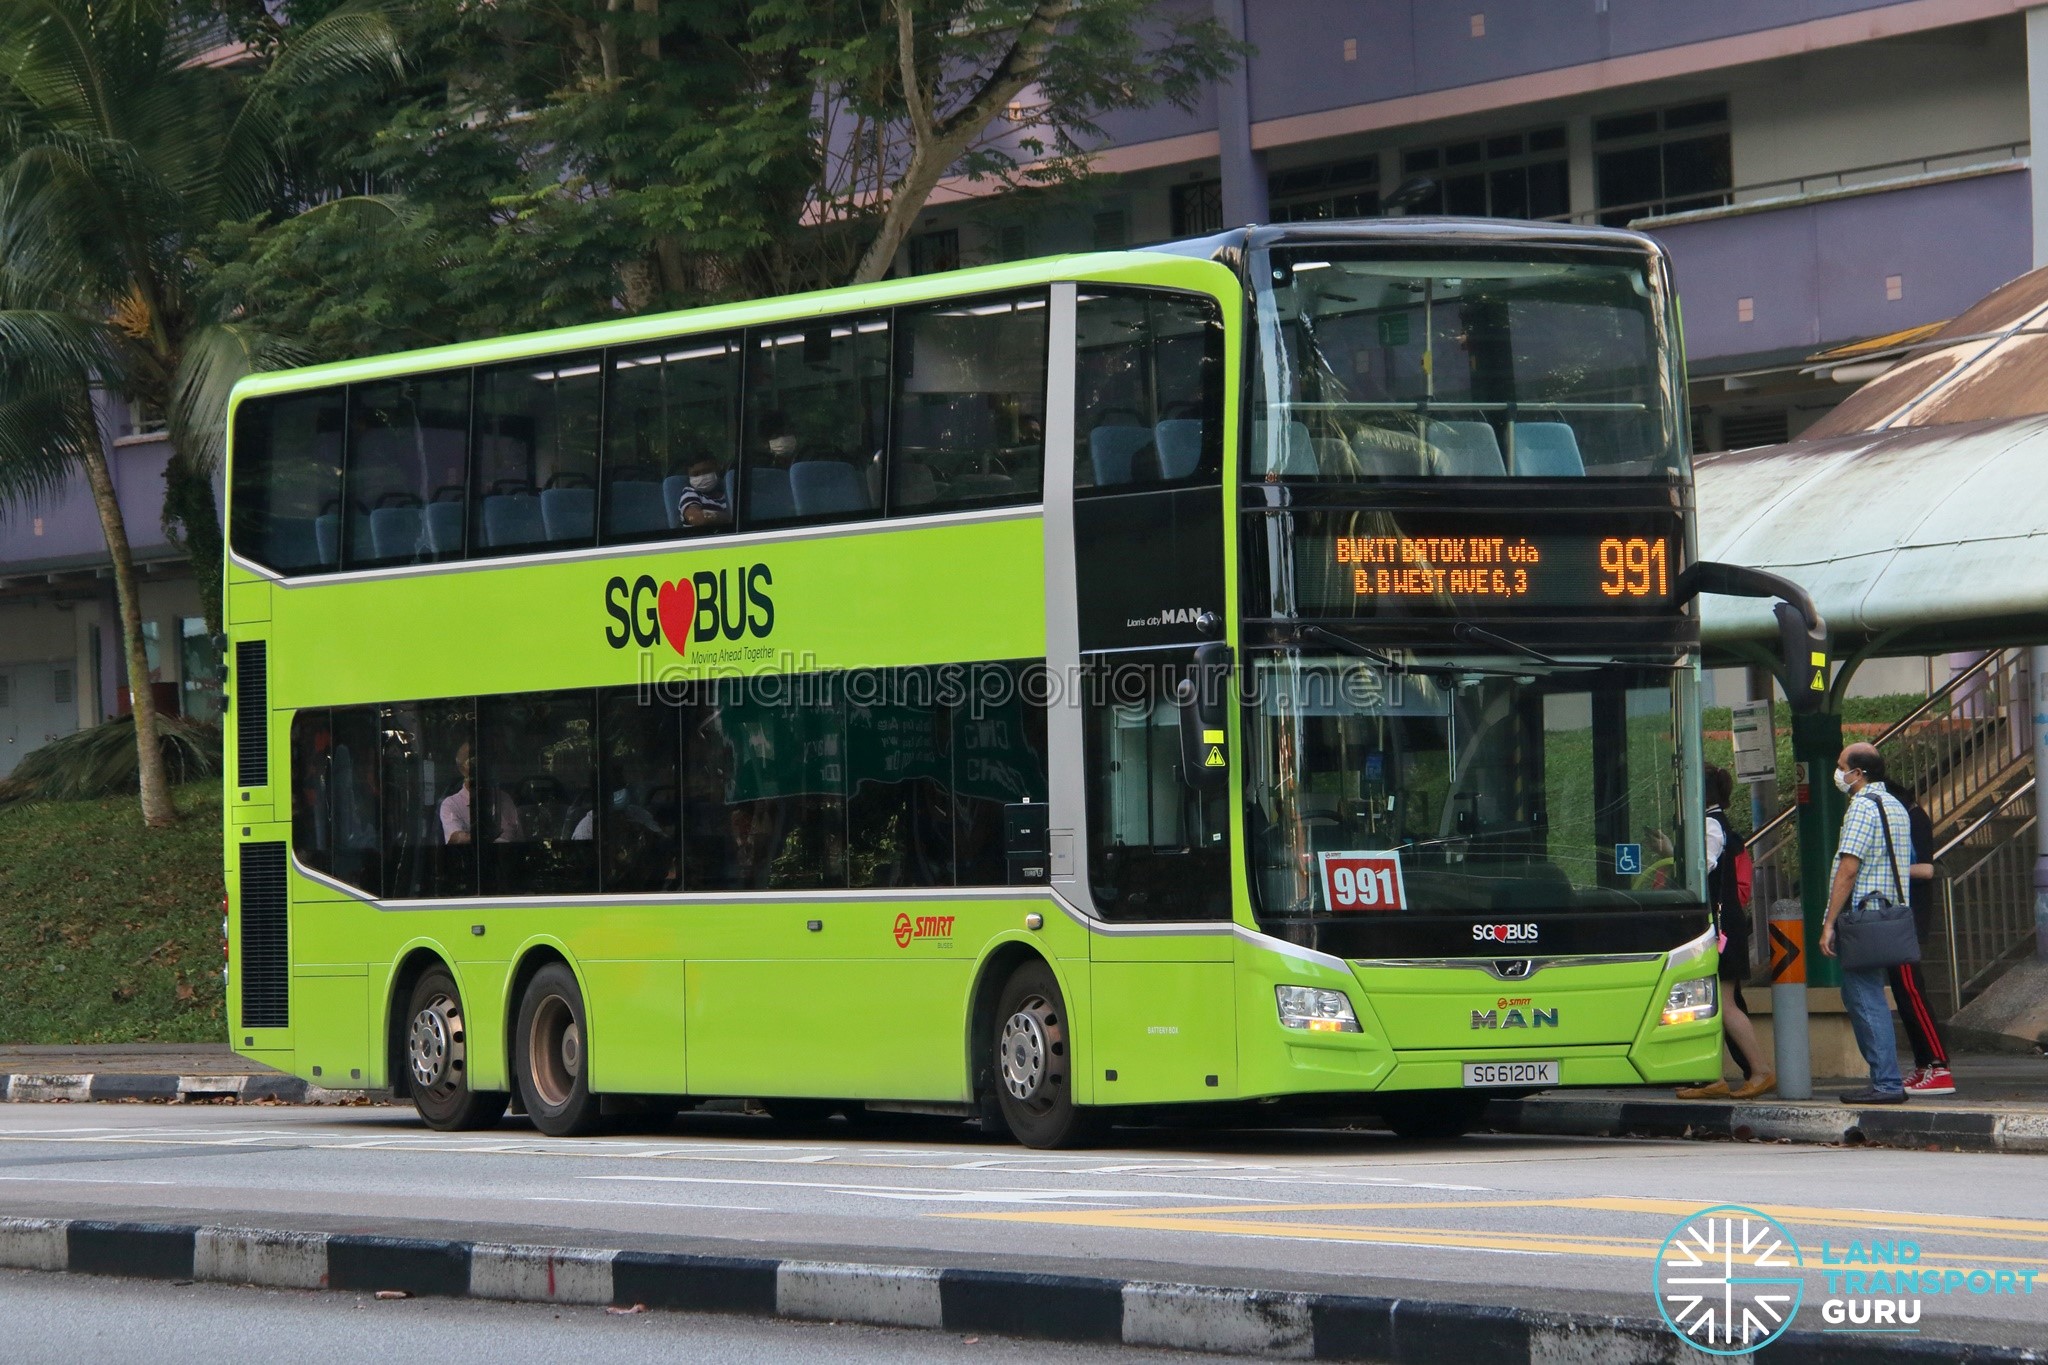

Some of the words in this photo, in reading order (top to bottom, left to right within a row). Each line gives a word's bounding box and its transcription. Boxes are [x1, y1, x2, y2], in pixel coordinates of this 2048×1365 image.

[1337, 538, 1398, 563] BUKIT
[1401, 538, 1466, 563] BATOK
[1469, 538, 1504, 563] INT
[1507, 538, 1540, 563] via
[1600, 538, 1667, 595] 991
[1393, 568, 1447, 594] WEST
[1450, 568, 1489, 593] AVE
[1161, 607, 1202, 625] MAN
[691, 650, 718, 665] Moving
[719, 647, 743, 662] Ahead
[744, 645, 776, 662] Together
[1333, 866, 1395, 905] 991
[913, 915, 956, 937] SMRT
[1508, 998, 1532, 1006] SMRT
[1470, 1008, 1559, 1030] MAN
[1473, 1064, 1549, 1083] SG6120K
